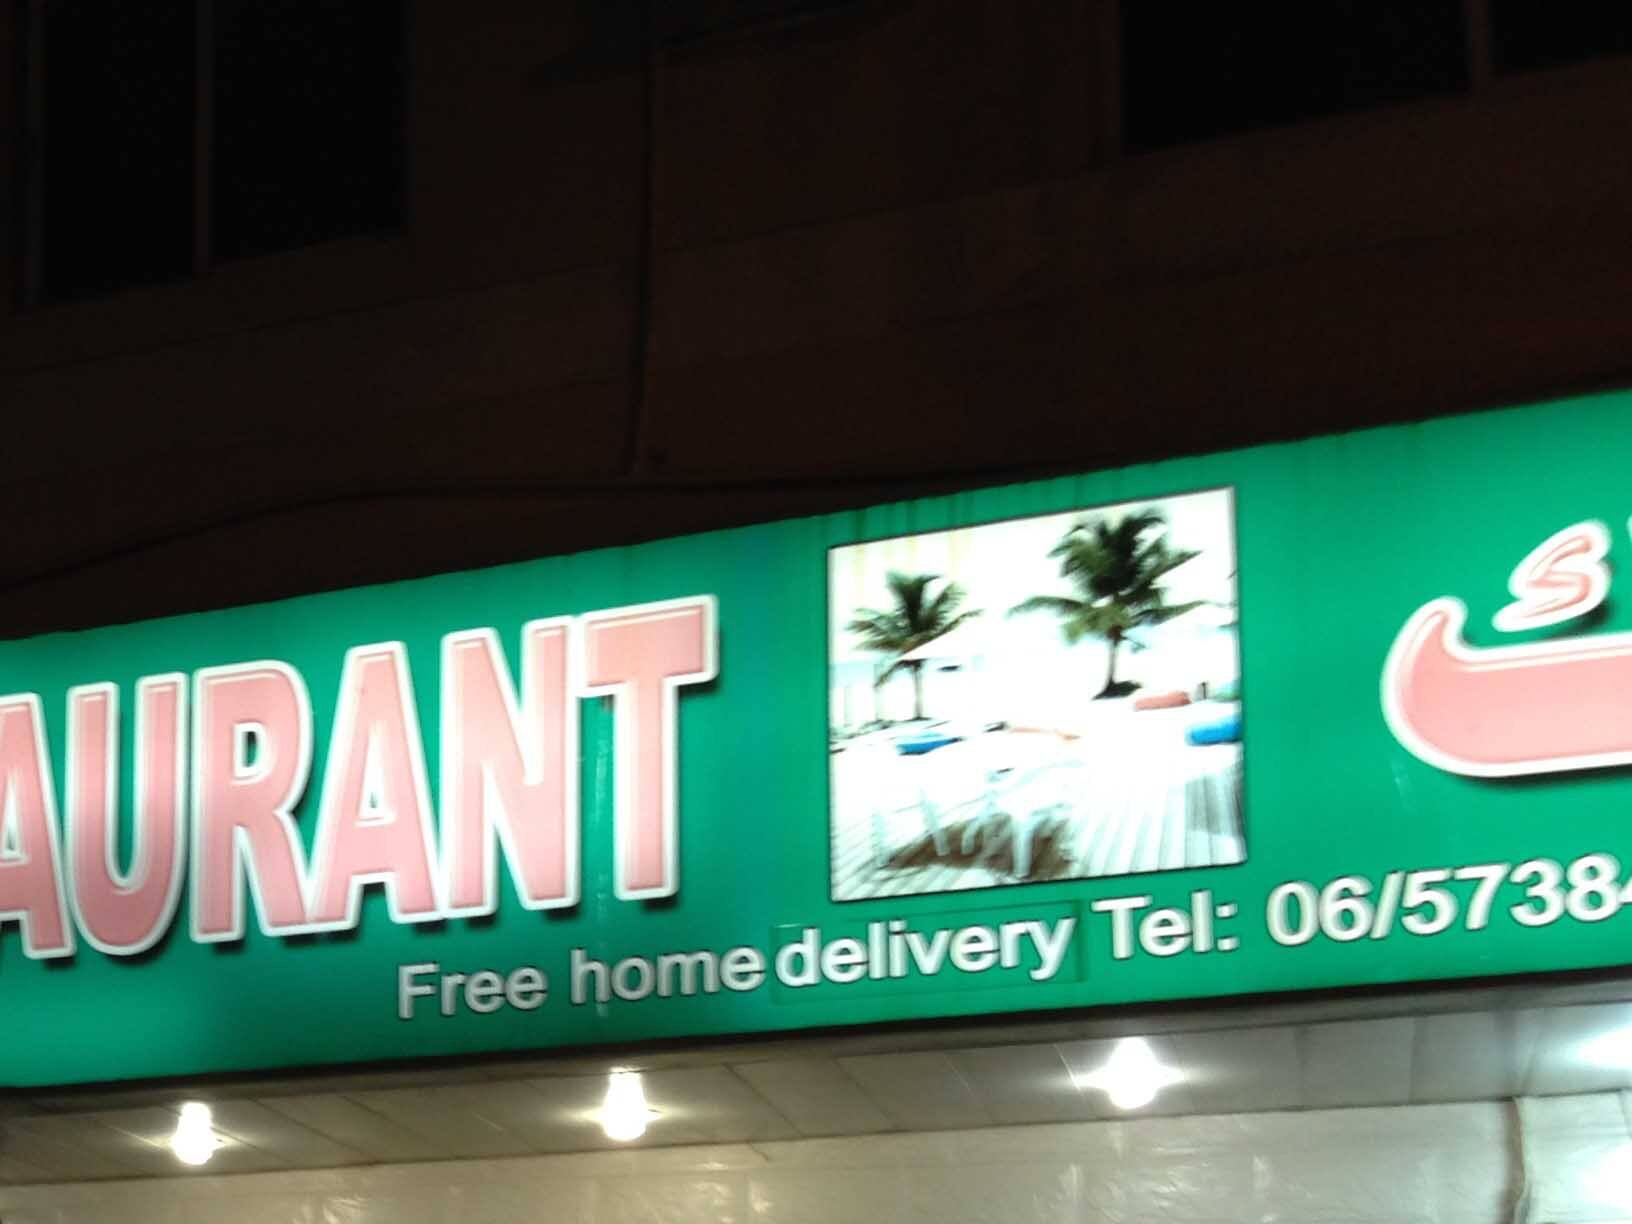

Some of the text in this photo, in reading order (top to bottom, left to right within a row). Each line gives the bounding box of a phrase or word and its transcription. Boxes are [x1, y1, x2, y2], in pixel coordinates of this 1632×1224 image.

[397, 851, 1632, 1020] Free home delivery Tel: 06/5738
